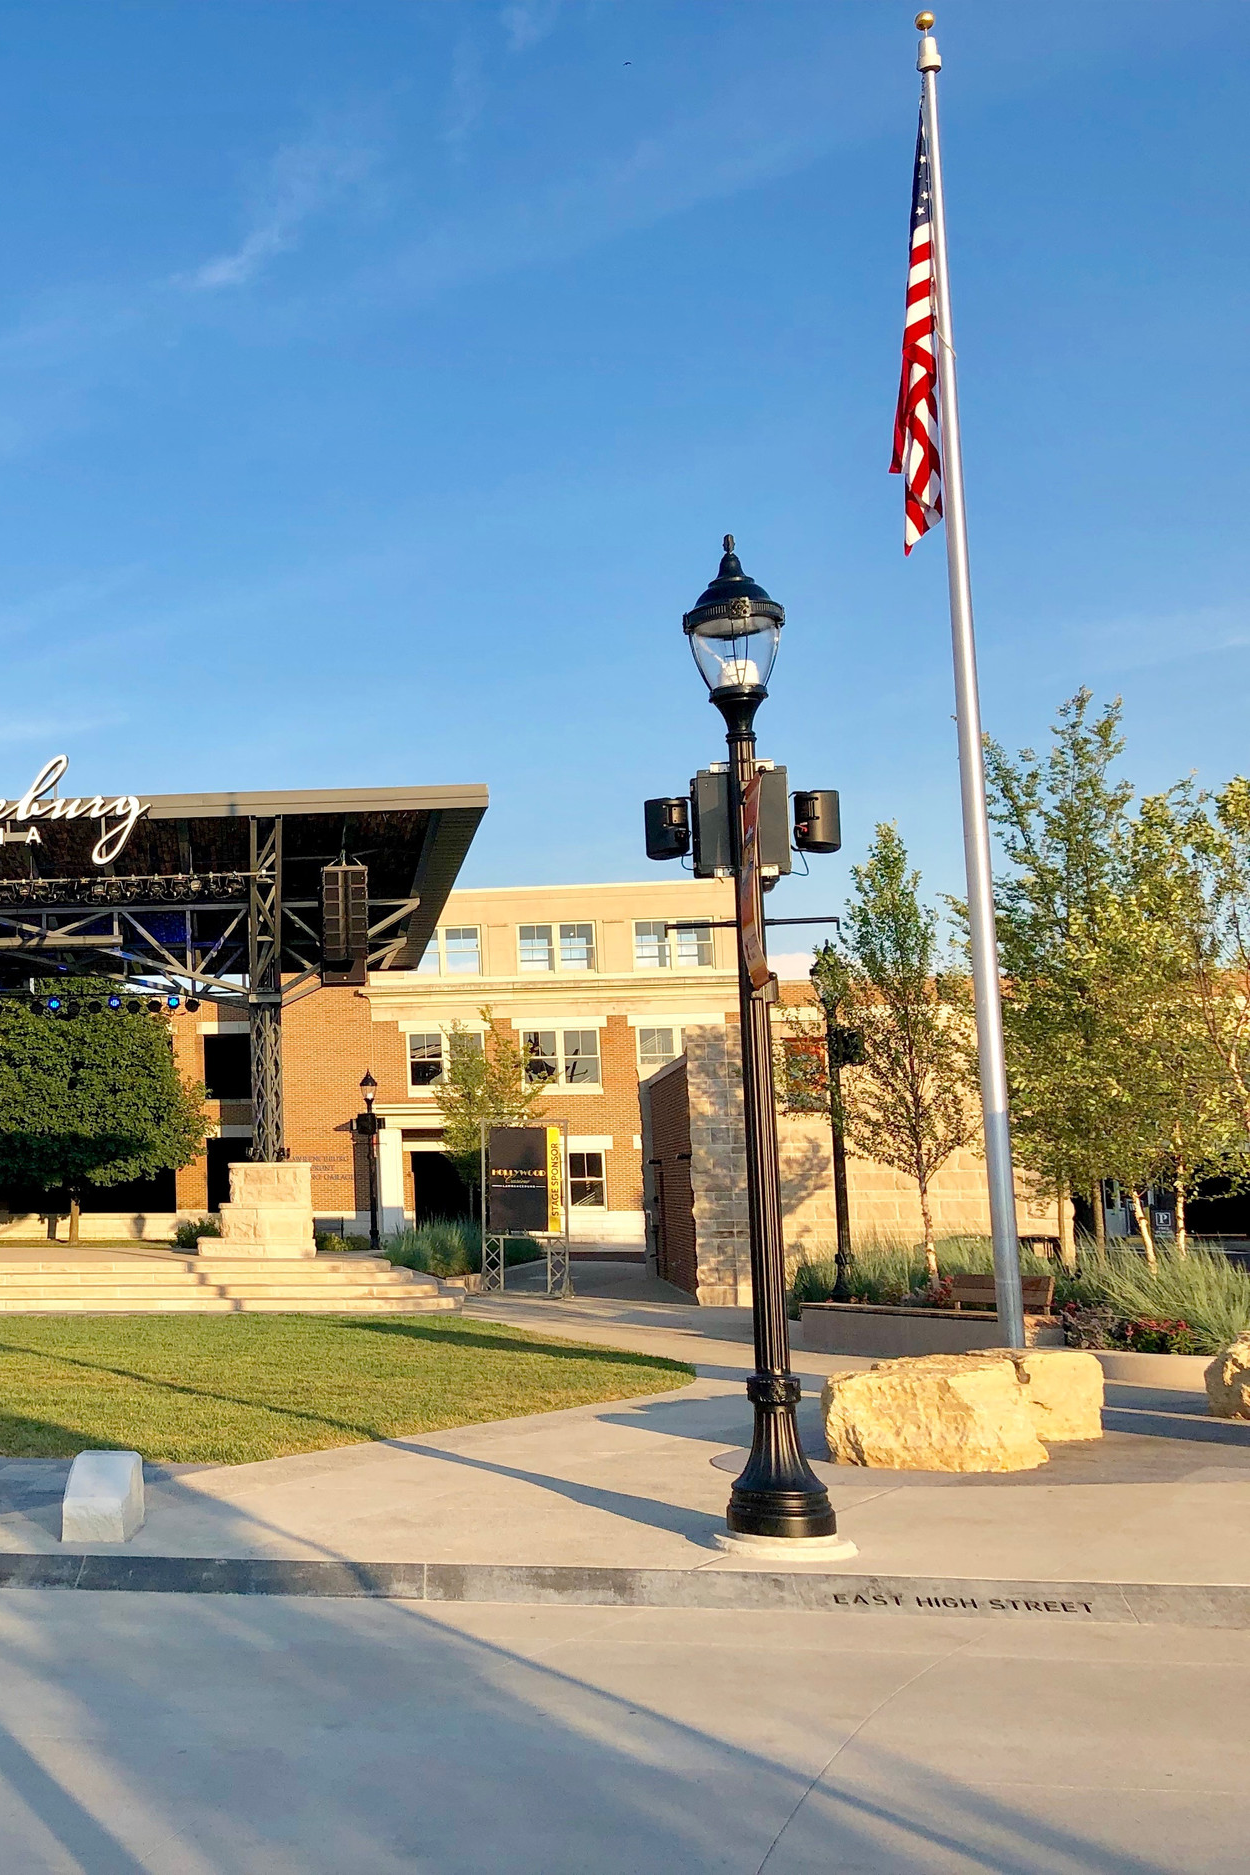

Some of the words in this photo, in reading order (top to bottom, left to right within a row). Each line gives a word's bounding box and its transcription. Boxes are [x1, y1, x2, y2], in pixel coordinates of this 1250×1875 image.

[491, 1169, 546, 1177] HOLLYWOOD
[551, 1143, 559, 1186] SPONSOR
[551, 1188, 559, 1216] STAGE
[833, 1593, 903, 1607] EAST
[916, 1596, 978, 1610] HIGH
[989, 1598, 1093, 1614] STREET
